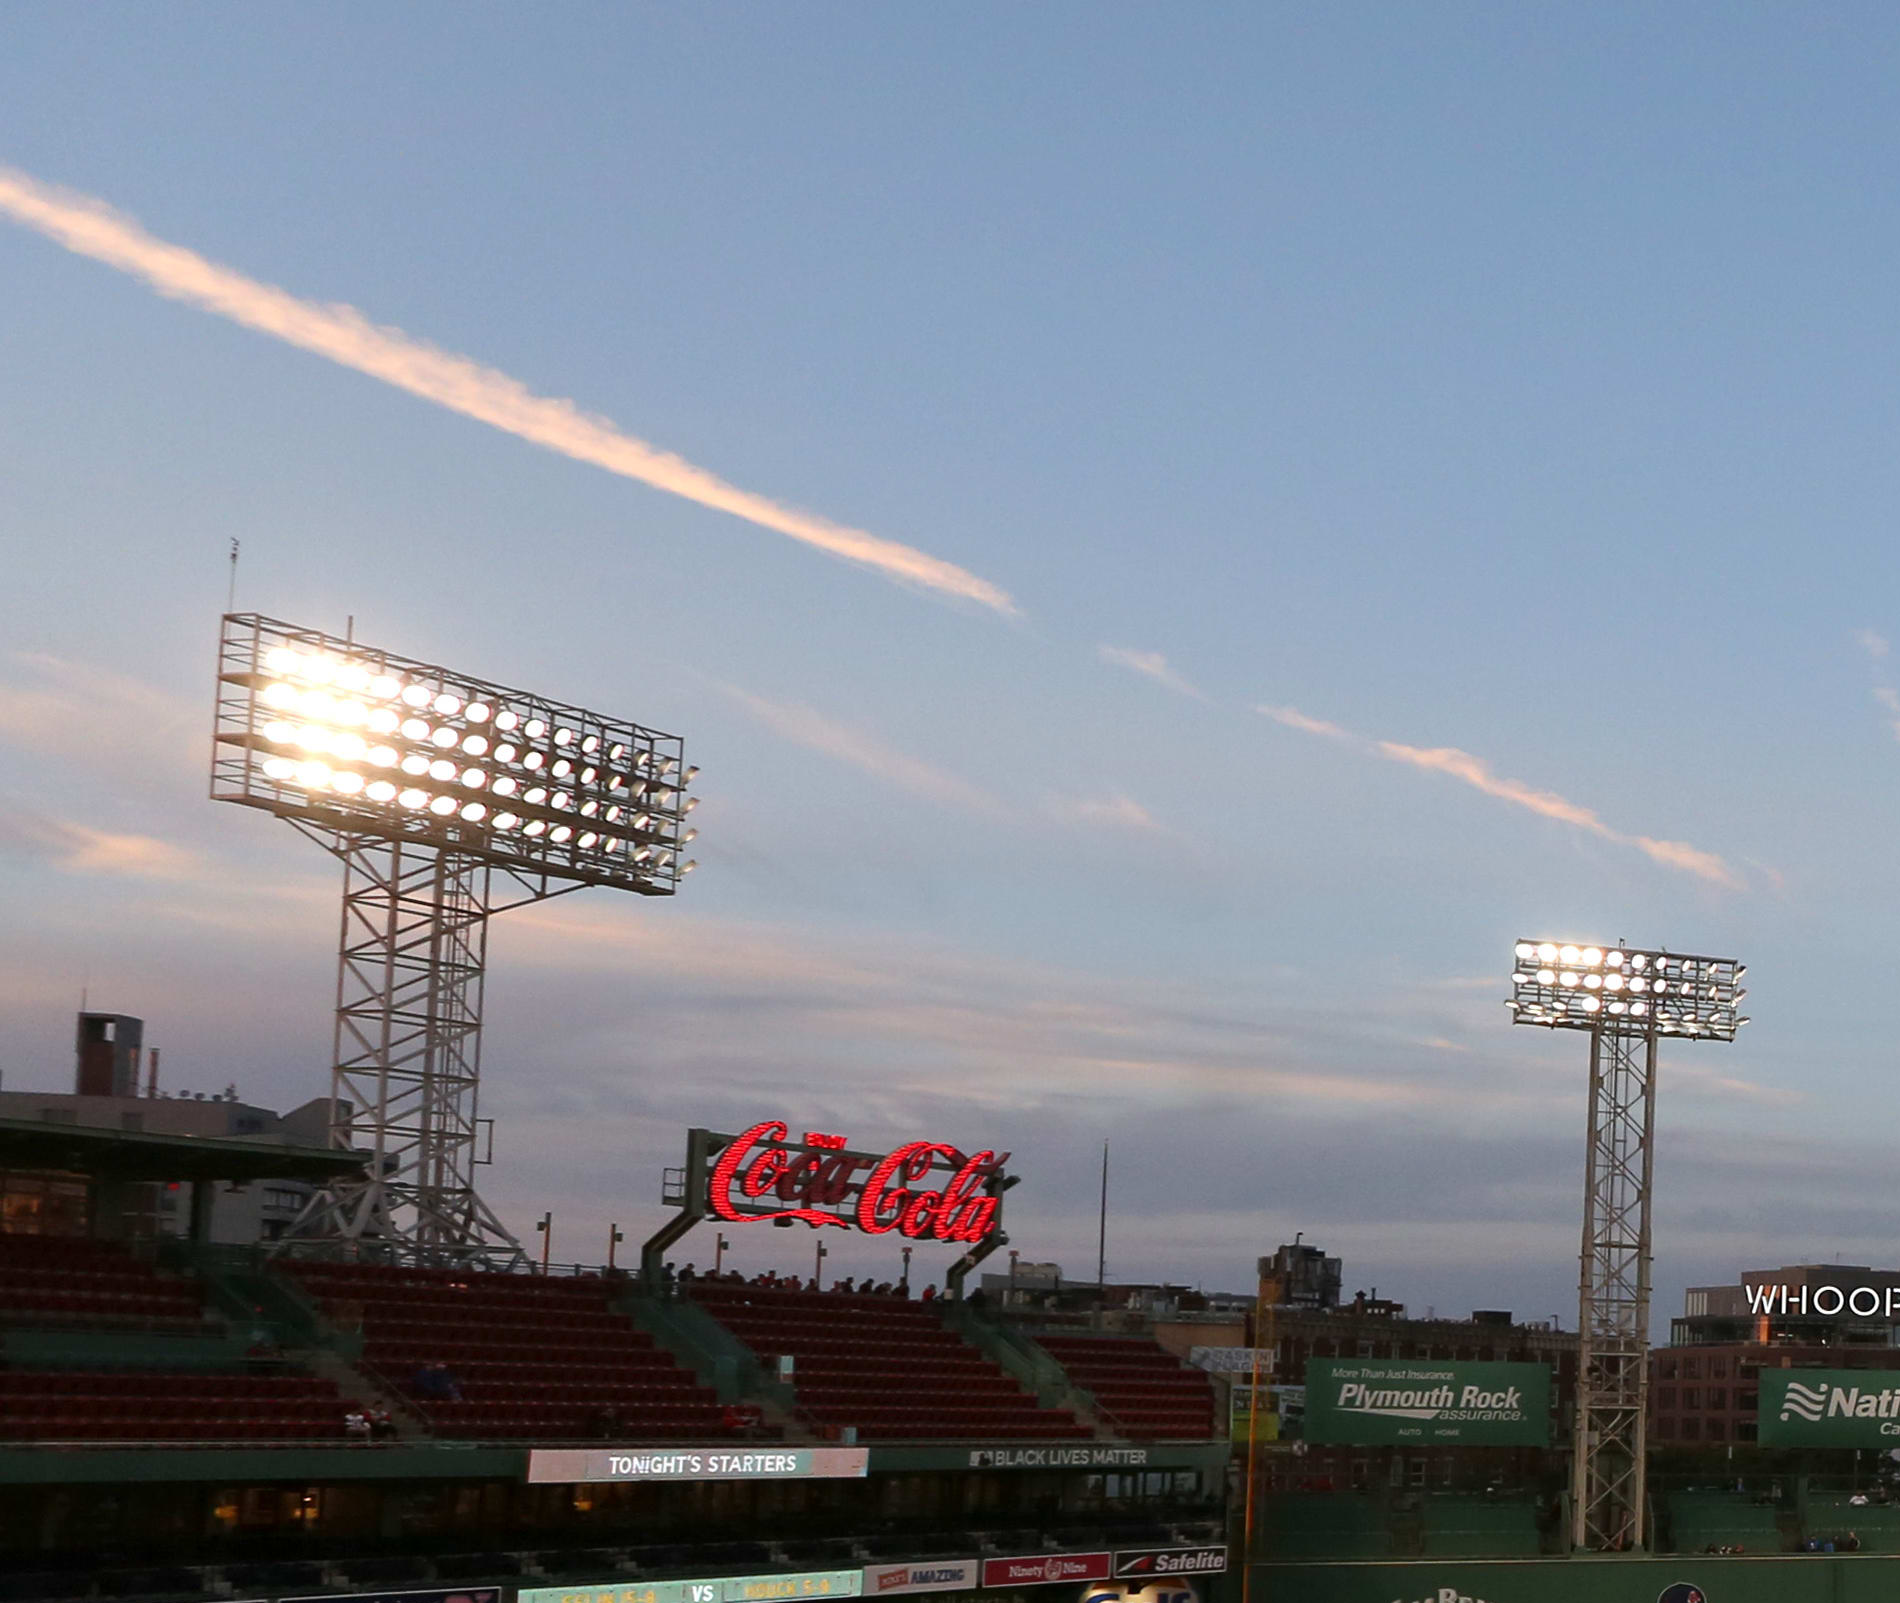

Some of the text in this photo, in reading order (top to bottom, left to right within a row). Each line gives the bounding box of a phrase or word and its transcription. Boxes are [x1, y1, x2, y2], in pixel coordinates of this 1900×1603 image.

[1337, 1383, 1522, 1410] Plymouth Rock
[1439, 1410, 1521, 1421] assurance
[709, 1455, 798, 1473] STARTERS
[996, 1449, 1147, 1467] BLACK LIVES MATTER
[1154, 1551, 1224, 1572] Safelite
[912, 1568, 965, 1585] AMAZING
[1009, 1563, 1088, 1579] Ninety Nine
[692, 1584, 715, 1603] VS
